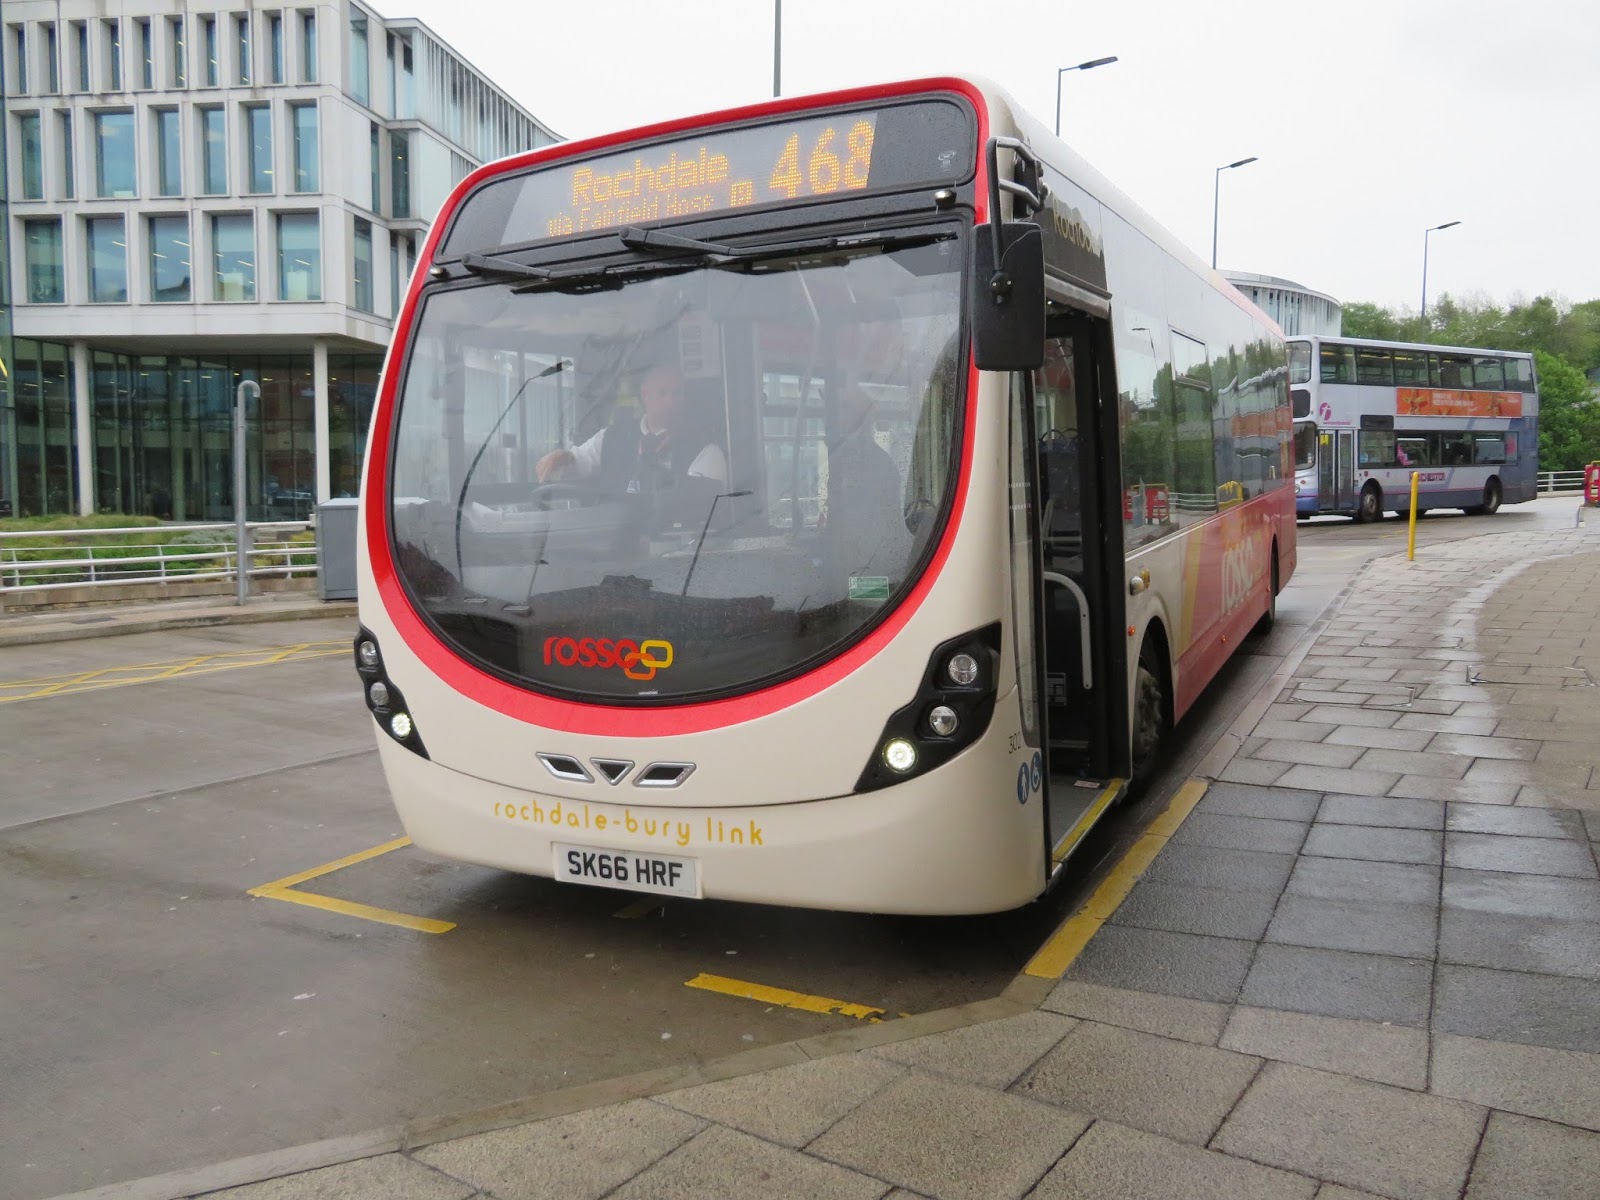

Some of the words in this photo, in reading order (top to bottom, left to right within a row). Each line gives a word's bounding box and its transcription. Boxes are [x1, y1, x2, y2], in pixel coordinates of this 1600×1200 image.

[571, 147, 729, 206] Rochdale
[768, 119, 876, 199] 468
[547, 211, 574, 238] via
[543, 636, 639, 668] rosso
[494, 800, 691, 847] rochdale-bury
[706, 816, 764, 846] link
[567, 850, 629, 881] SK66
[635, 859, 683, 888] HRF
